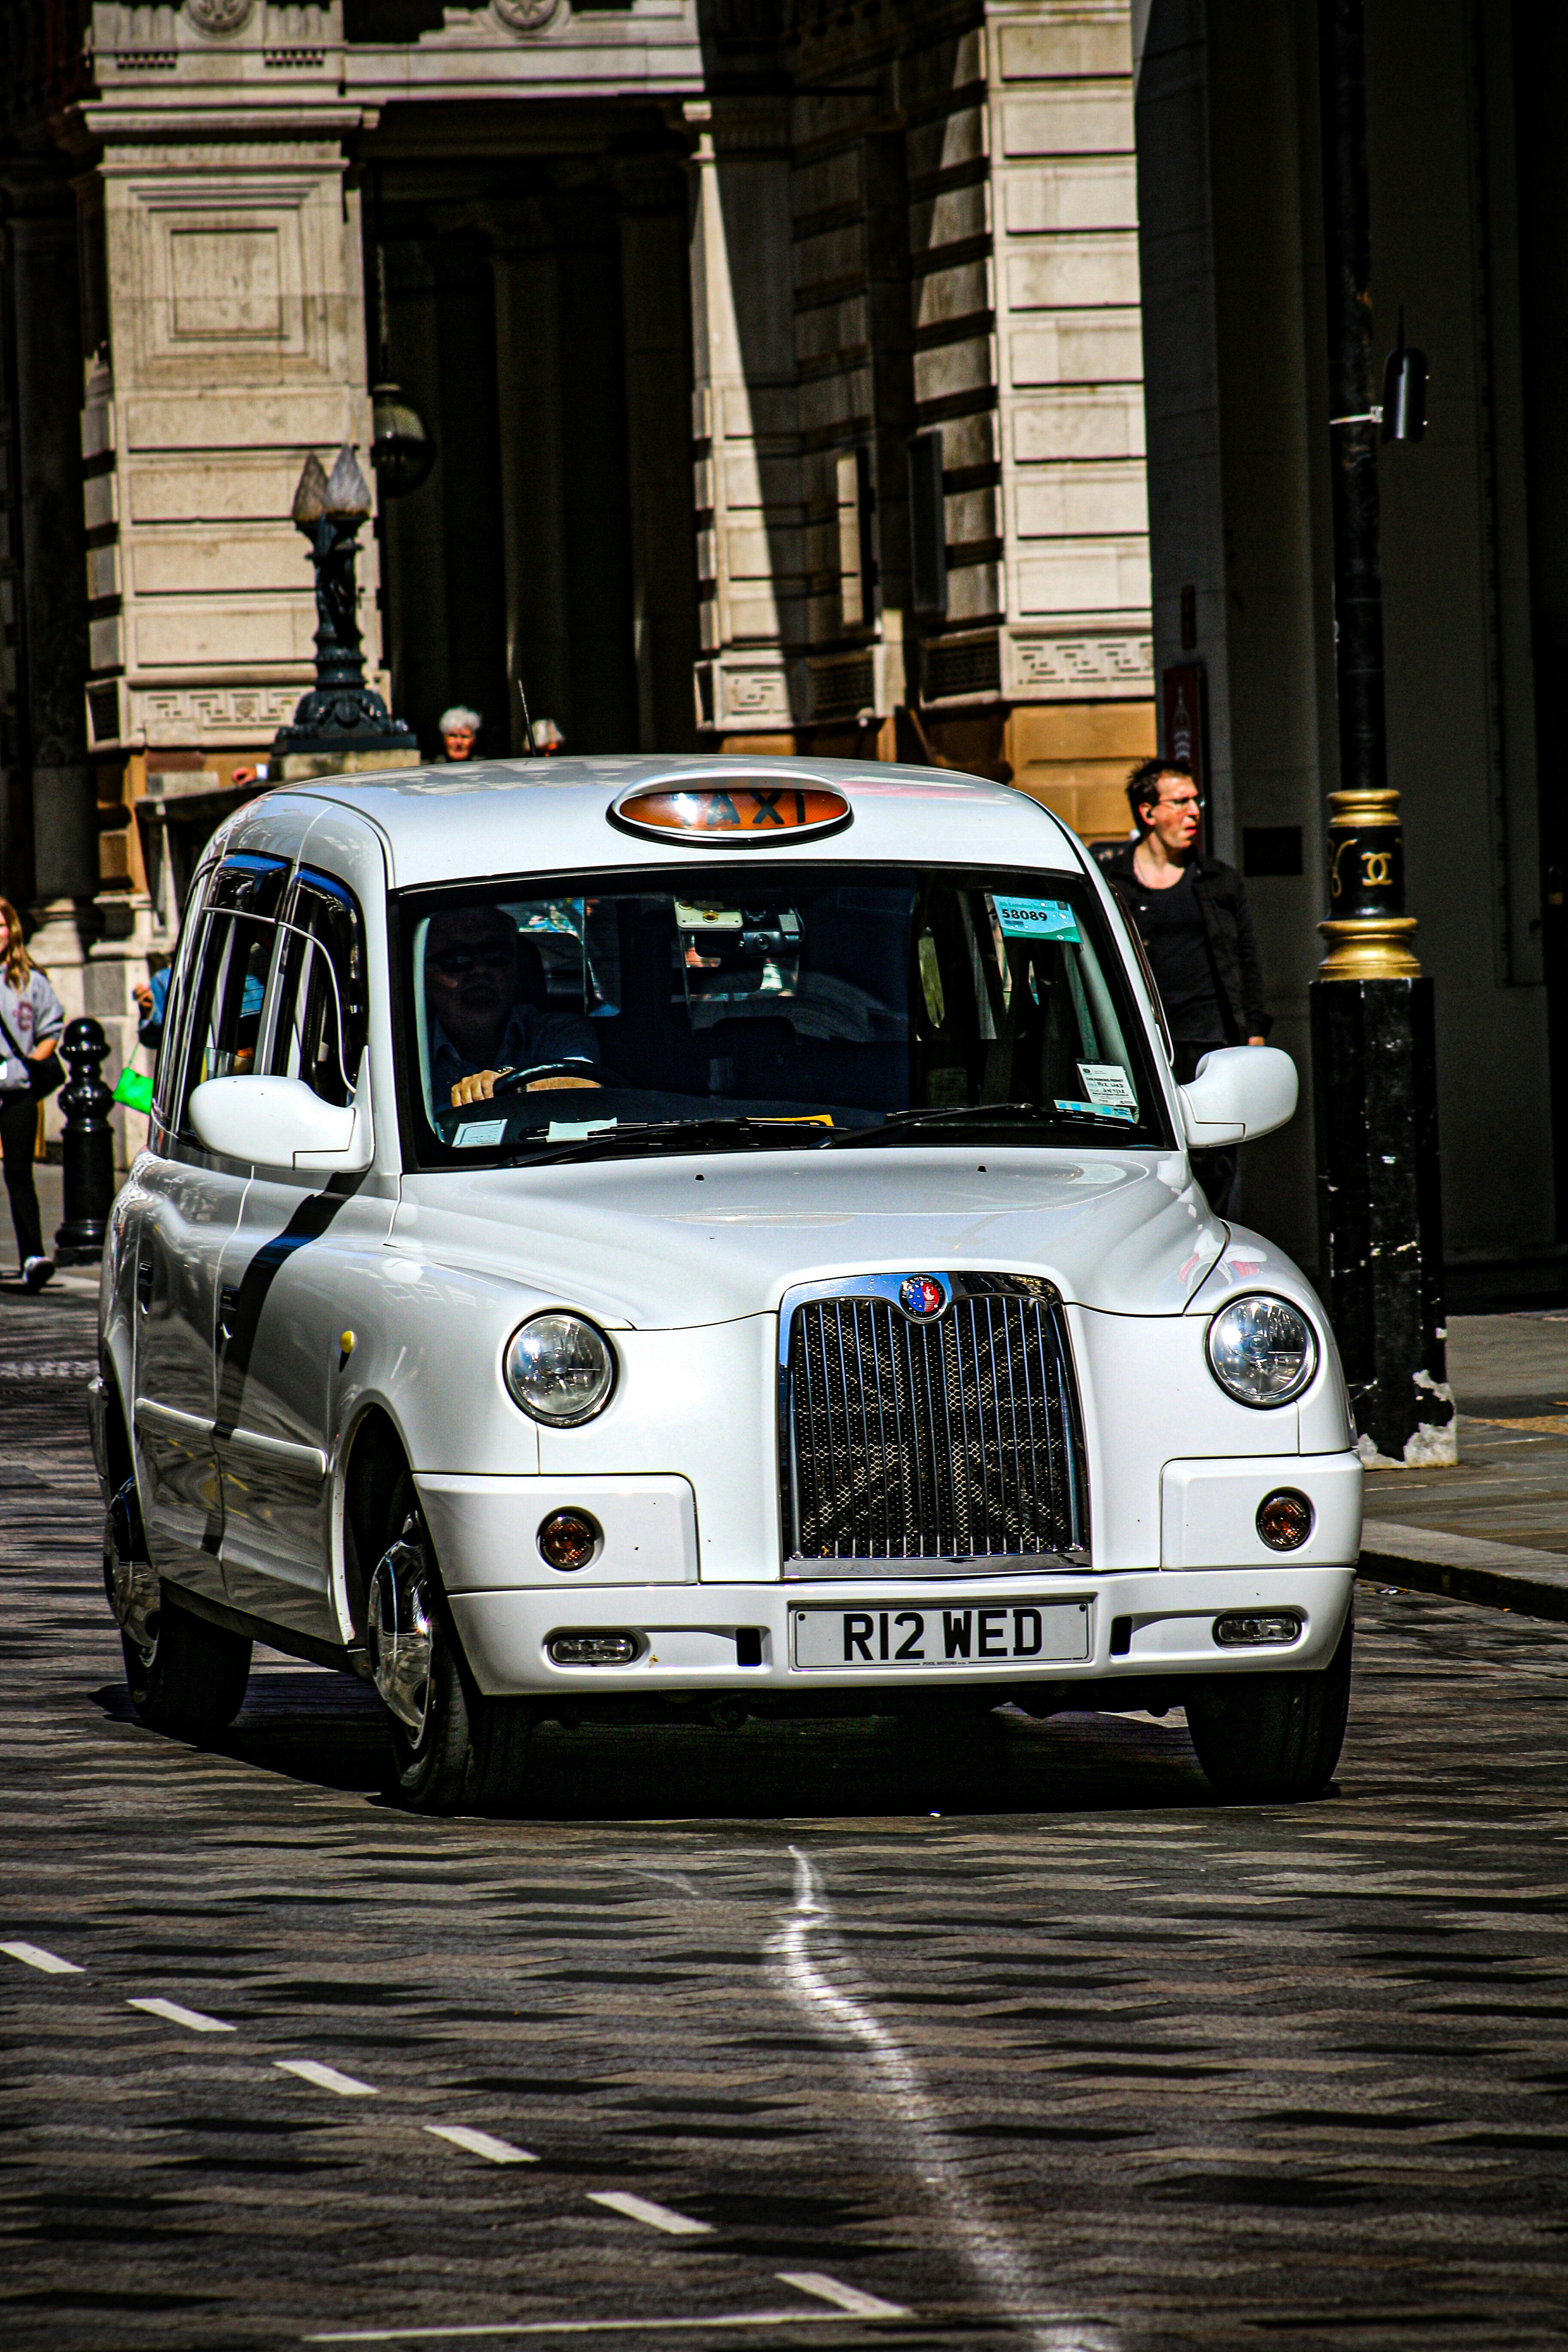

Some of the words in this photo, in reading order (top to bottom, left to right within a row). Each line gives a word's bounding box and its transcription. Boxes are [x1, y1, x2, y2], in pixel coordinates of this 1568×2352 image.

[671, 790, 806, 826] AXI
[1002, 908, 1047, 922] 58089
[843, 1612, 925, 1661] R12
[943, 1608, 1042, 1659] WED
